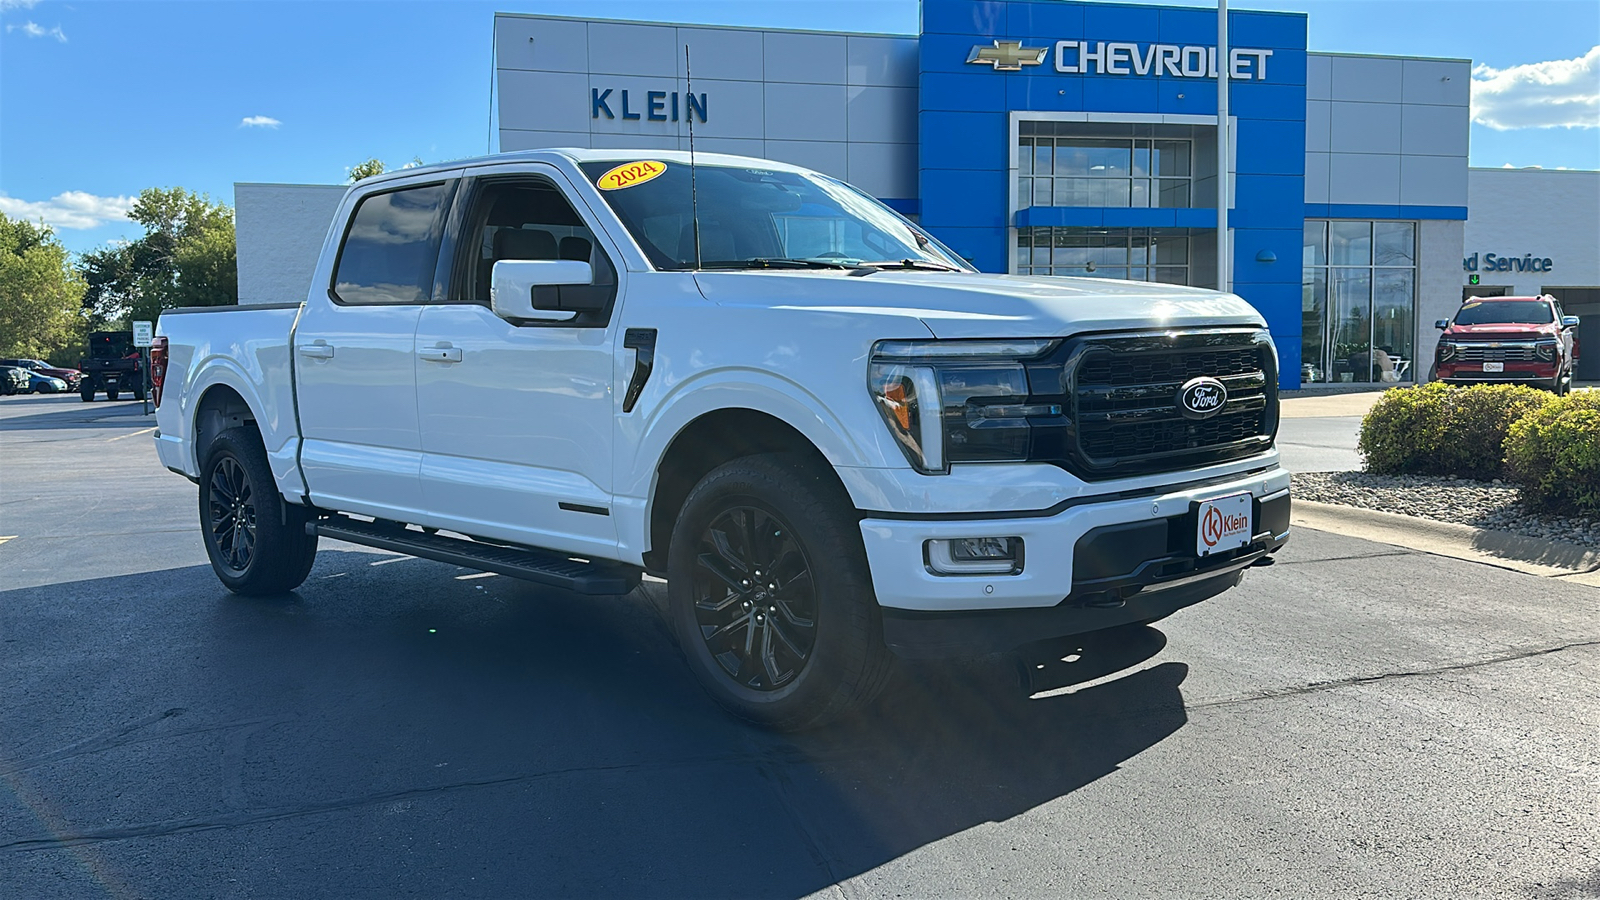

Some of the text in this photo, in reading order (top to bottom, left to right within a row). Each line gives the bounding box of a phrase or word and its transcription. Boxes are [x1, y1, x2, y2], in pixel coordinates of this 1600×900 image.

[1055, 40, 1273, 80] CHEVROLET
[592, 88, 708, 123] KLEIN
[610, 162, 658, 187] 2024
[1484, 252, 1553, 272] Service
[1192, 386, 1219, 408] Ford
[1224, 513, 1248, 532] Klein
